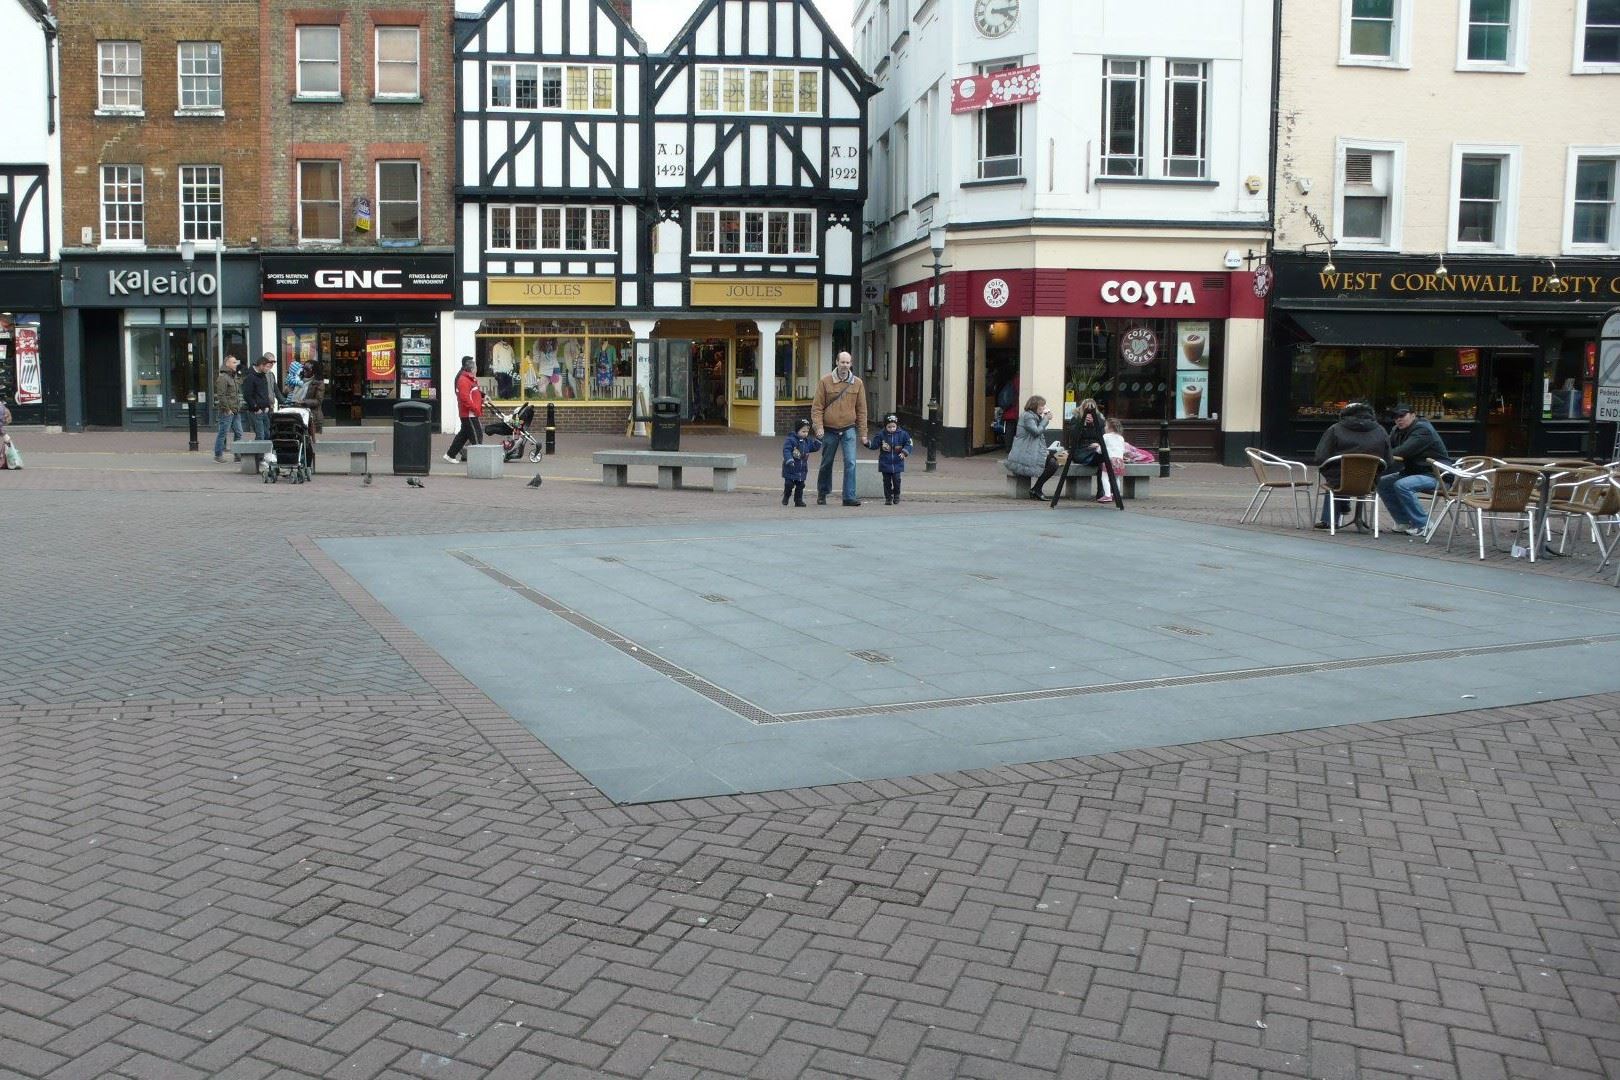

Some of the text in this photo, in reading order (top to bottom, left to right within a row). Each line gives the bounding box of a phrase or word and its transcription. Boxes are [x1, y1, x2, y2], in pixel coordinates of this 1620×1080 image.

[657, 165, 685, 176] 1422
[830, 167, 857, 179] 1922
[109, 269, 217, 296] Kaleido
[314, 270, 402, 288] GNC
[1319, 272, 1382, 290] WEST
[1390, 273, 1521, 293] CORNWALL
[523, 284, 581, 296] JOULES
[726, 285, 783, 297] JOULES
[988, 281, 1004, 290] COSTA
[1100, 280, 1196, 306] COSTA
[1127, 329, 1152, 341] COSTA
[1124, 348, 1154, 362] COFFEE
